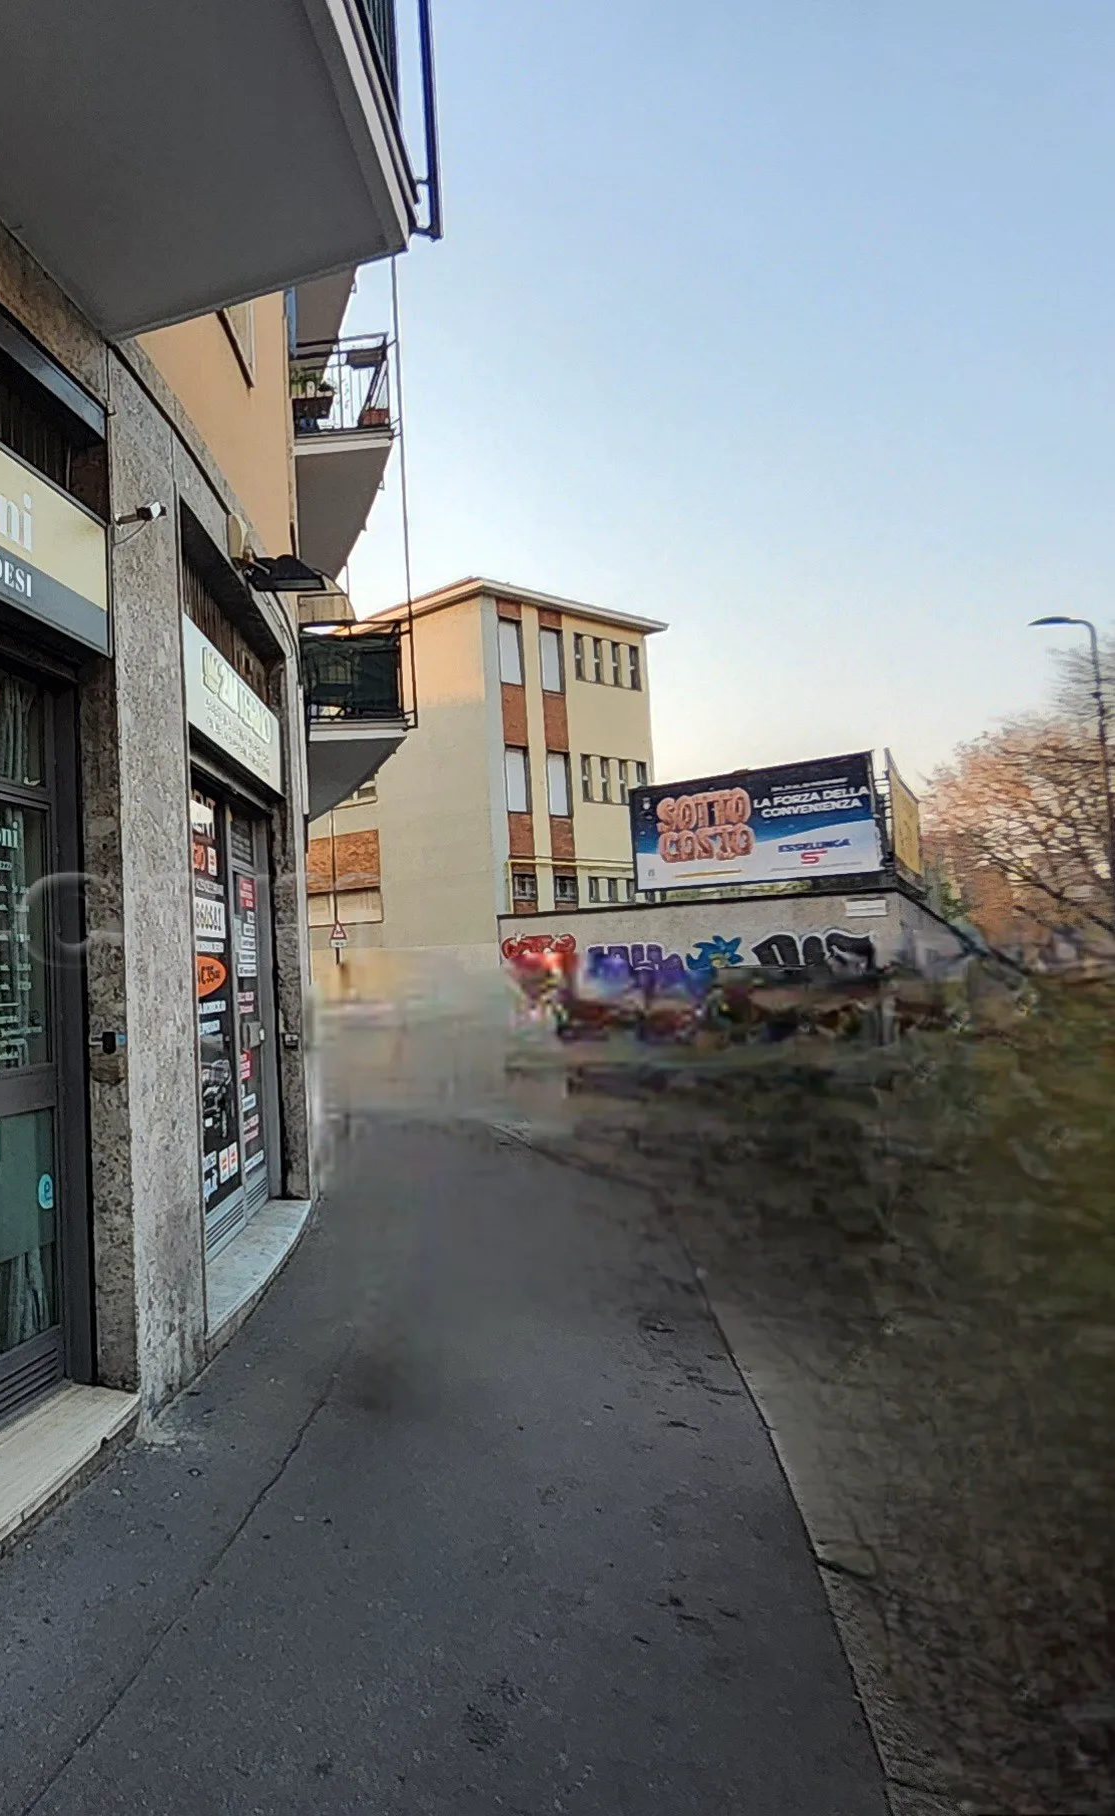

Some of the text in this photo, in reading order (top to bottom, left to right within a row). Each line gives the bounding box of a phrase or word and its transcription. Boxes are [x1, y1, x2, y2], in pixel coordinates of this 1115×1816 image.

[656, 787, 752, 833] SOTTO
[754, 786, 870, 809] LA FORZA DELLA
[761, 799, 864, 819] CONVENIENZA
[658, 823, 756, 864] COSTO
